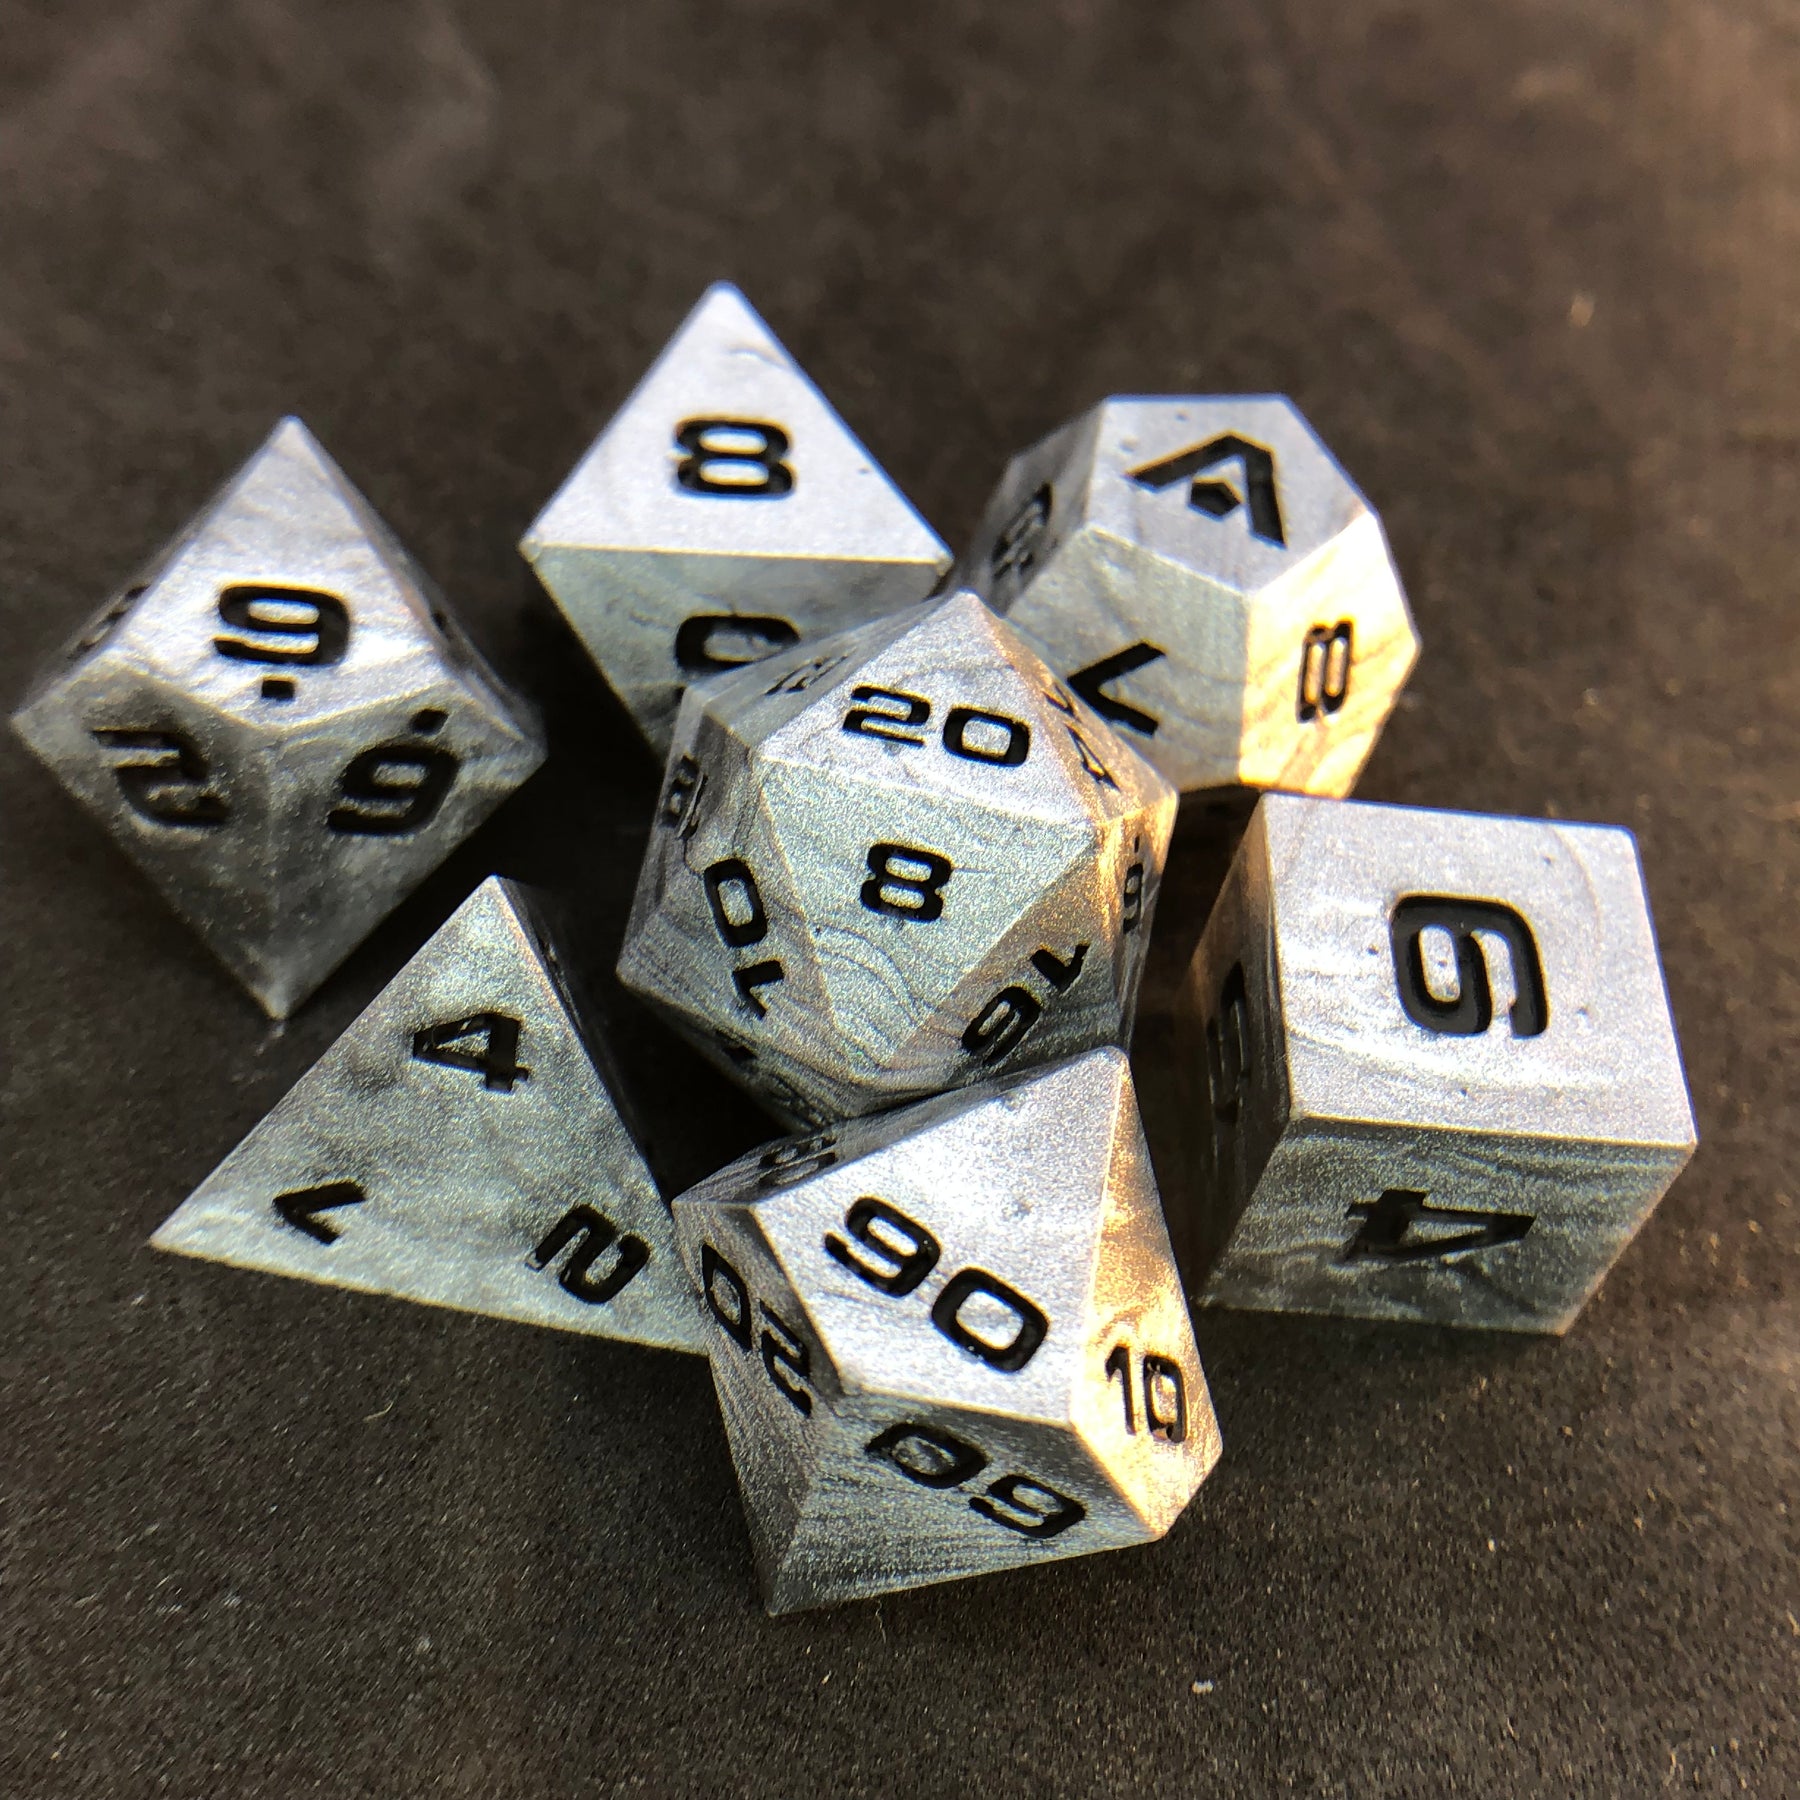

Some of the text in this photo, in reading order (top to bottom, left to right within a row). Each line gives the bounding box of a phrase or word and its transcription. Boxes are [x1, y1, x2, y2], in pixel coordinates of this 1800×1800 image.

[674, 417, 796, 497] 8
[842, 684, 1030, 768] 20
[860, 842, 952, 923] 8
[413, 1012, 530, 1095] 4
[527, 1203, 652, 1305] 2
[1338, 1188, 1536, 1263] 4
[824, 1196, 1050, 1373] 90
[1106, 1345, 1187, 1443] 10
